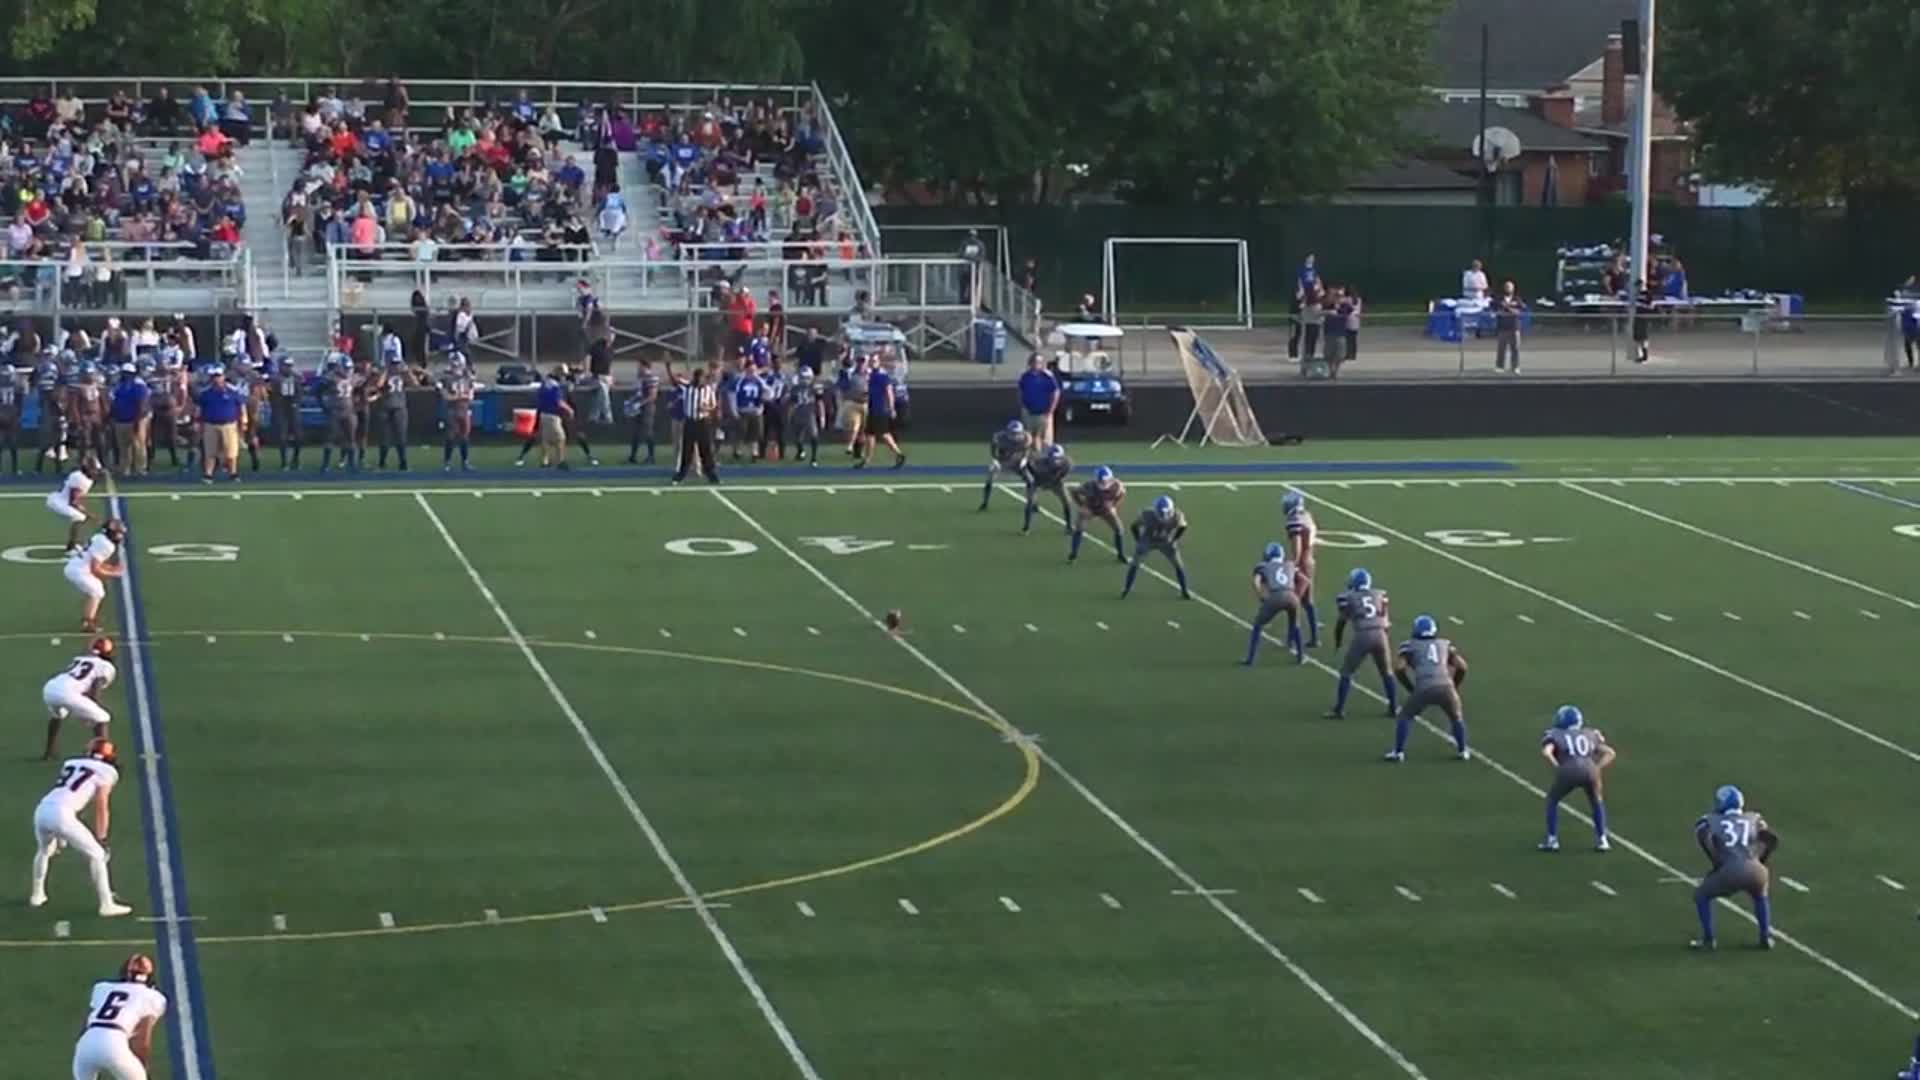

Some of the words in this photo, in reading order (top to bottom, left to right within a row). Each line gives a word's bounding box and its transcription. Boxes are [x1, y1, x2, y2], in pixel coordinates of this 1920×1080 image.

[1275, 567, 1289, 585] 6
[1361, 596, 1376, 618] 5
[1427, 643, 1438, 664] 4
[1564, 734, 1588, 756] 10
[1720, 819, 1749, 847] 37
[96, 991, 129, 1020] 6
